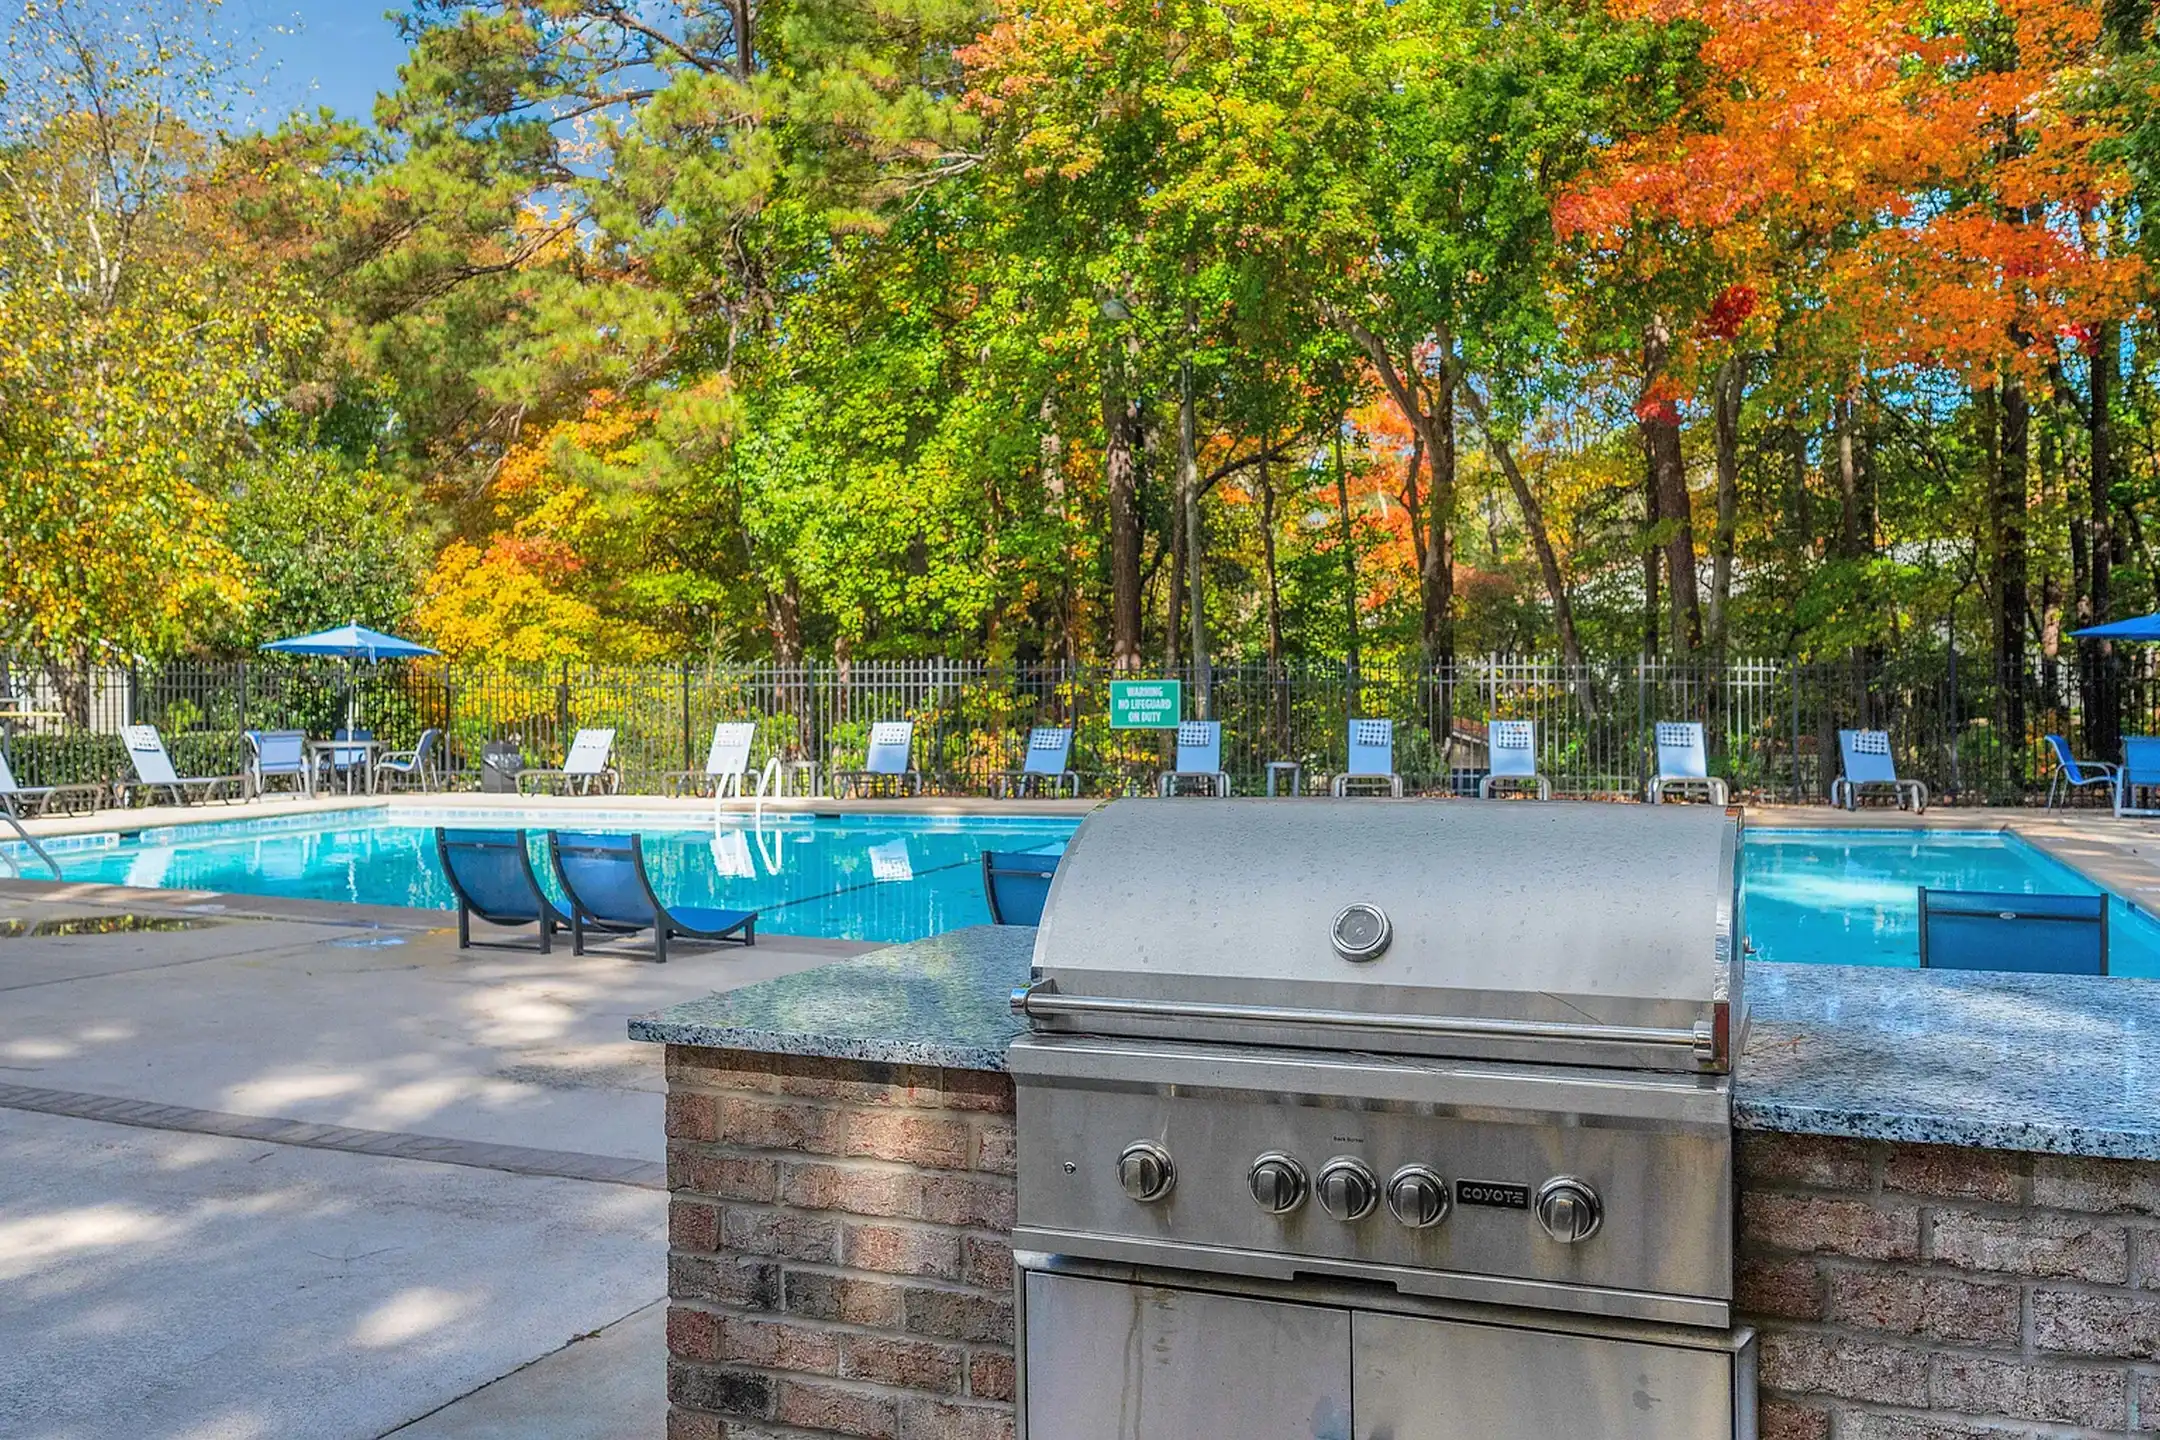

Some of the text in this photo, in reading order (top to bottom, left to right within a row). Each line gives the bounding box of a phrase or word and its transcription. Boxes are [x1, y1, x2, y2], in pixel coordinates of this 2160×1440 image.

[1126, 686, 1163, 697] WARNING
[1118, 698, 1172, 710] NO LIFEGUARD
[1128, 711, 1161, 722] ON DUTY
[1462, 1187, 1524, 1204] COYOTE
